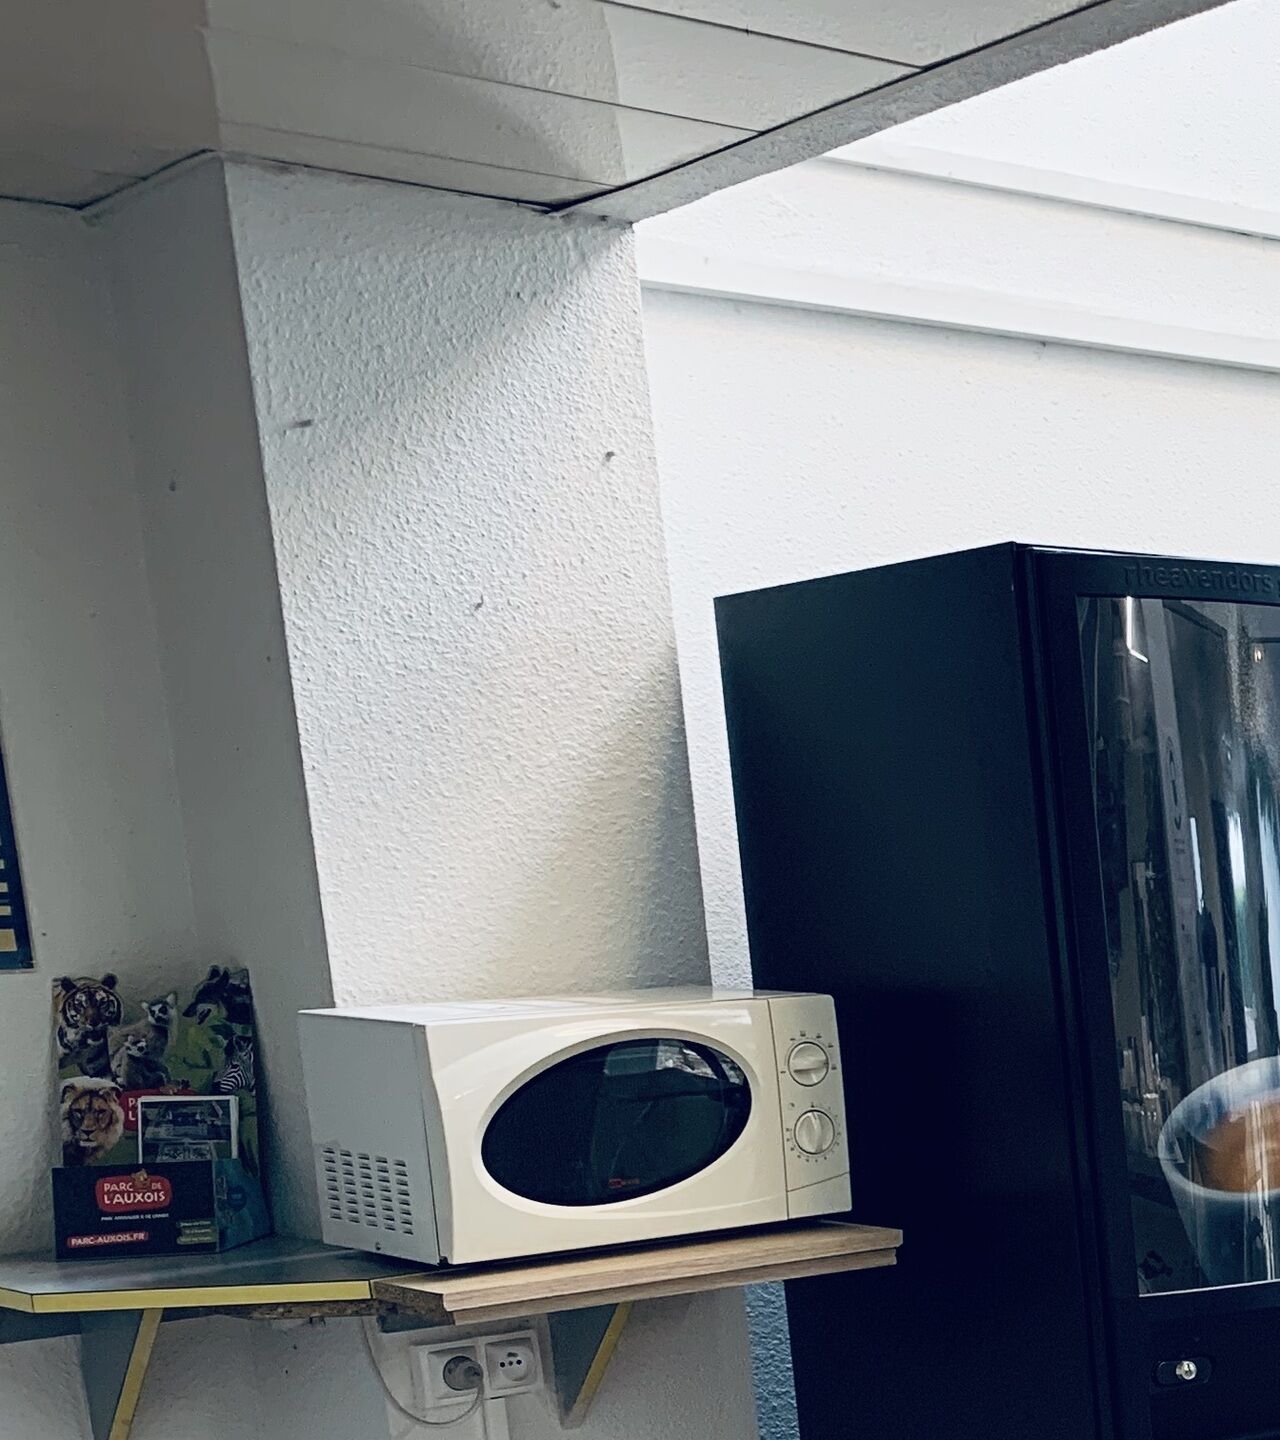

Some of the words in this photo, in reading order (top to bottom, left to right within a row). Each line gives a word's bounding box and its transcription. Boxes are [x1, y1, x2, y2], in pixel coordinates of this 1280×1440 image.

[1124, 564, 1273, 594] rheavendors
[104, 1181, 134, 1193] PARC
[152, 1181, 163, 1190] DE
[71, 1232, 145, 1246] PARC-AUXOIS.FR
